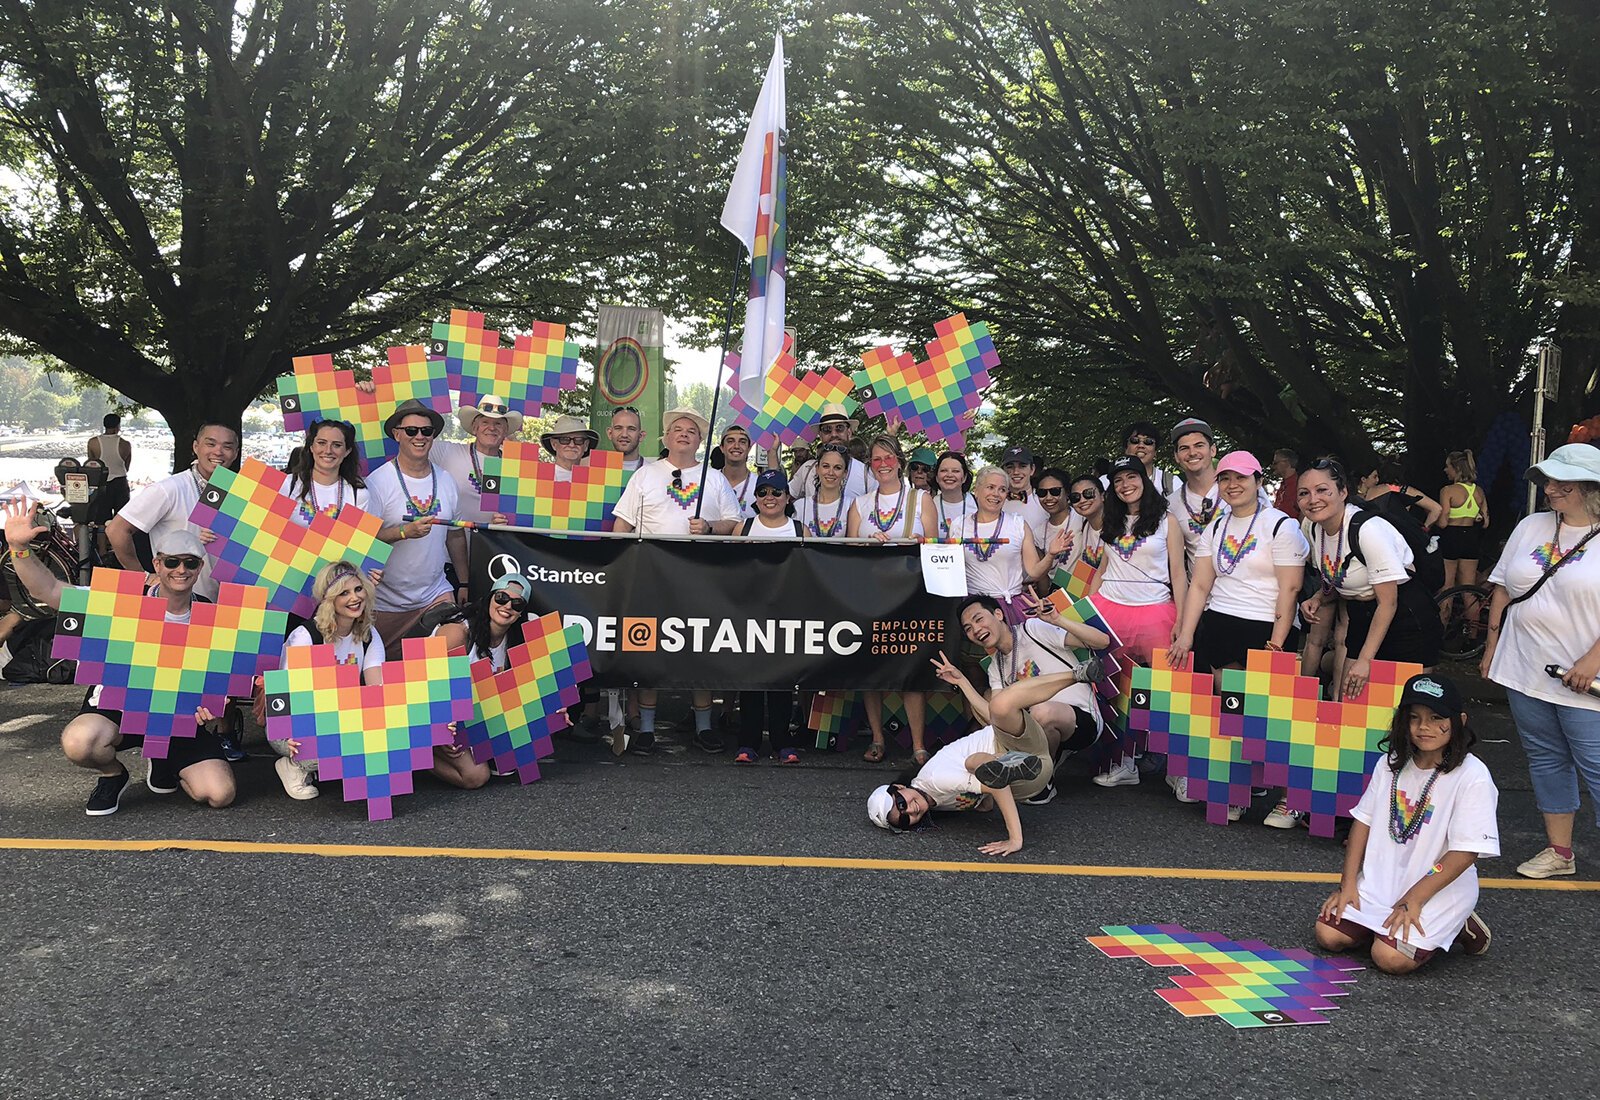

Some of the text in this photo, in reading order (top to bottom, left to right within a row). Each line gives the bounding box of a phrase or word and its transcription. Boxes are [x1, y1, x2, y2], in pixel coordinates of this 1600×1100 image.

[931, 555, 954, 563] GW1
[526, 564, 606, 585] Stantec
[872, 620, 945, 631] EMPLOYEE
[872, 632, 945, 642] RESOURCE
[871, 644, 918, 655] GROUP
